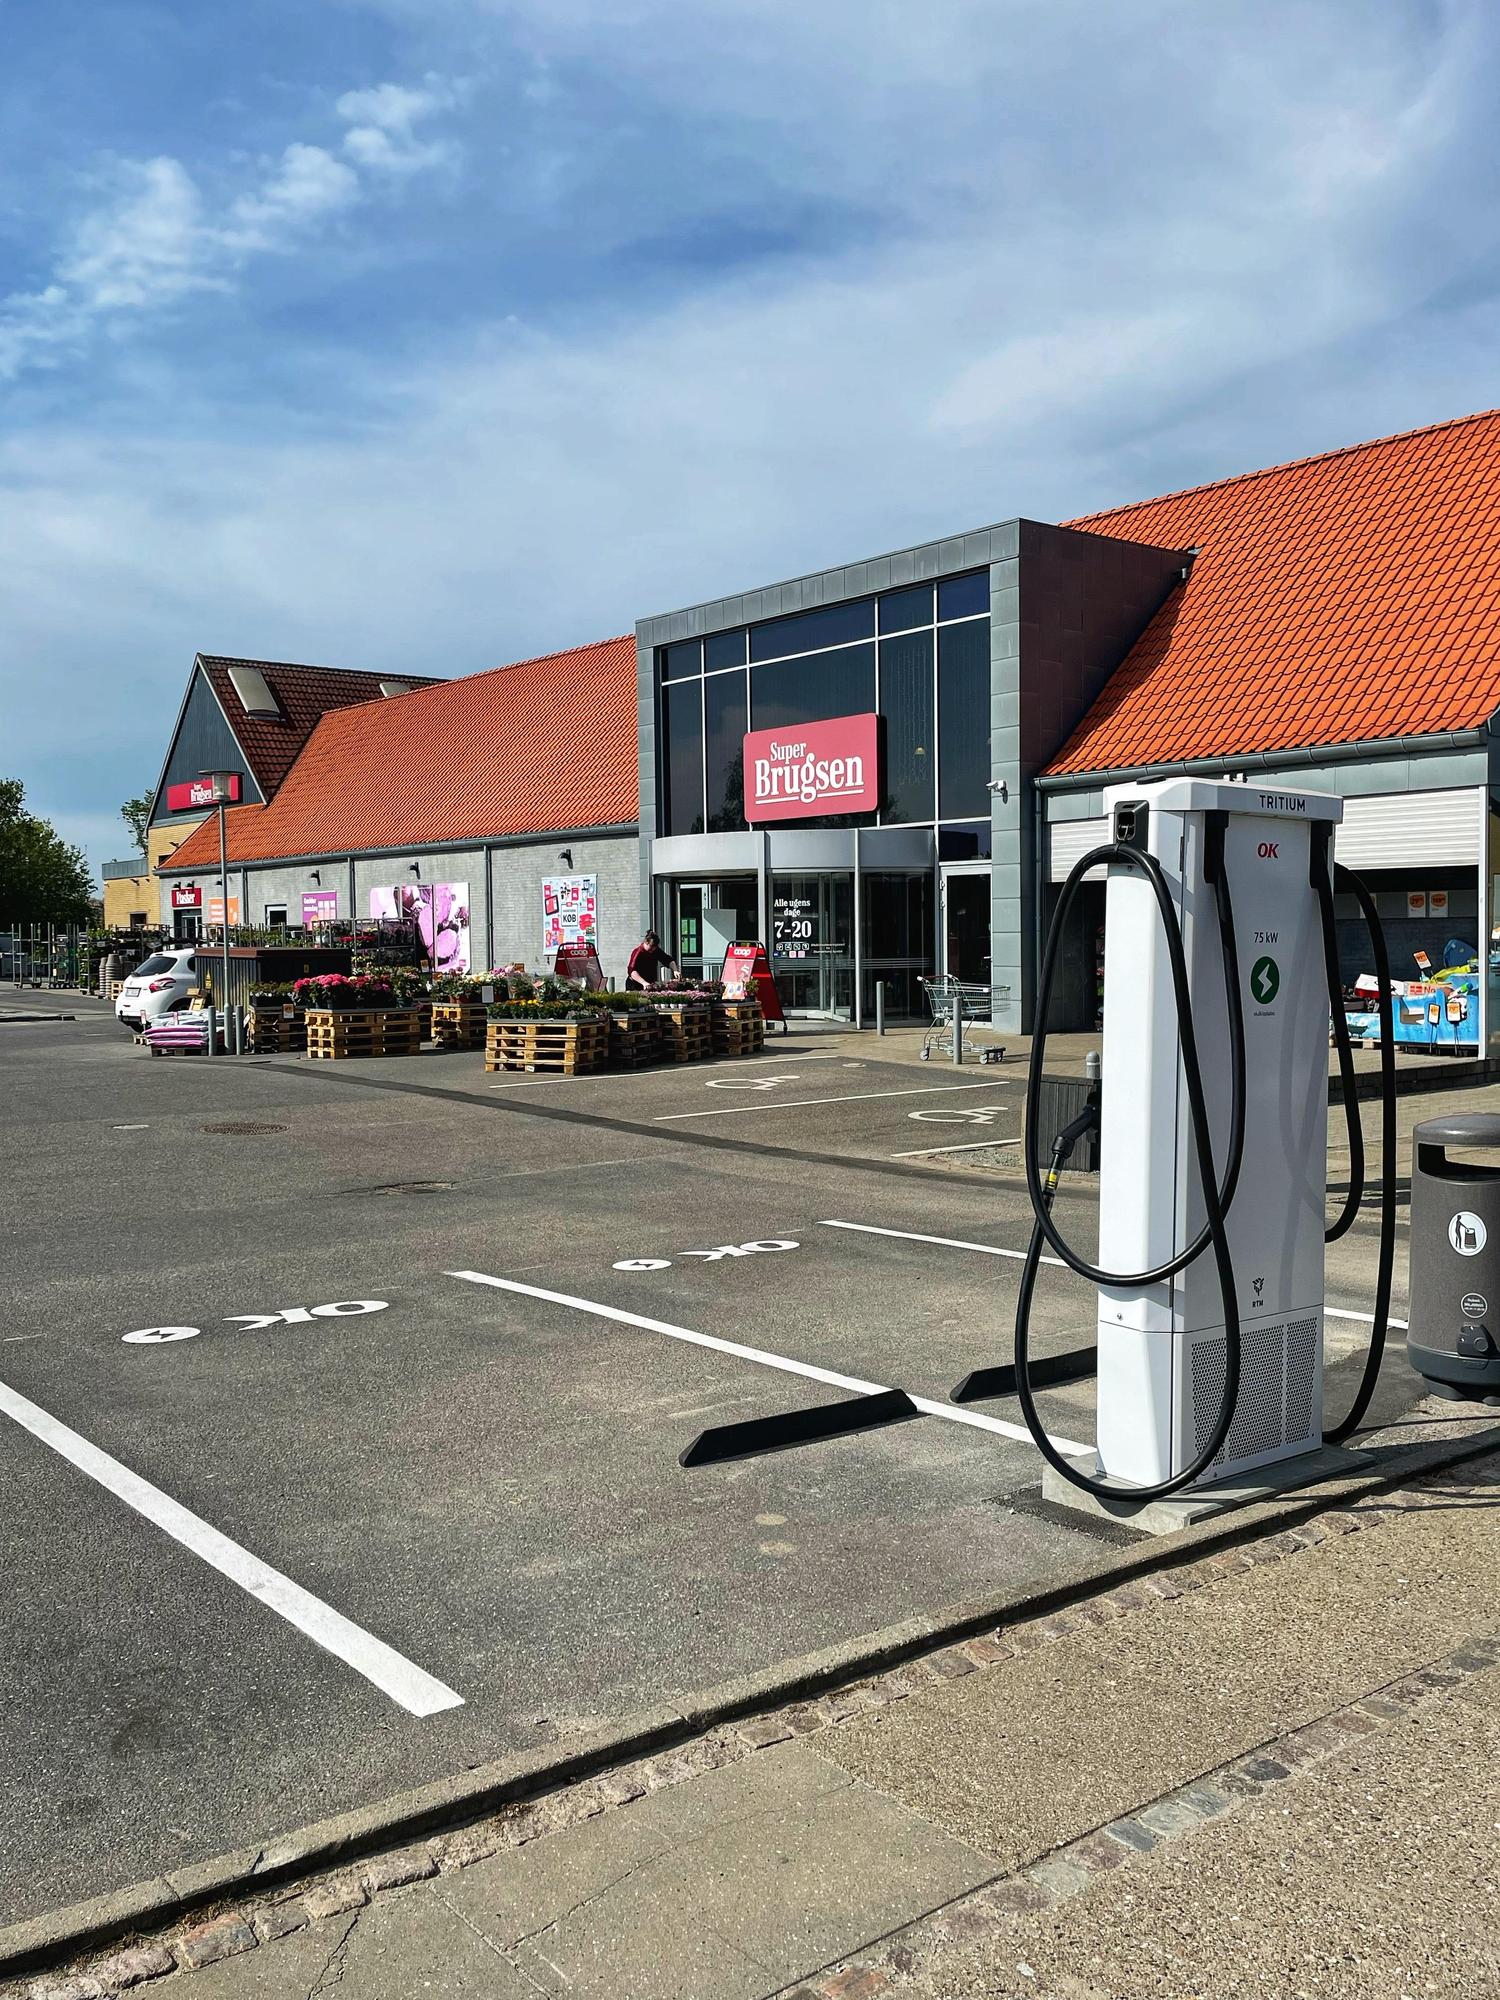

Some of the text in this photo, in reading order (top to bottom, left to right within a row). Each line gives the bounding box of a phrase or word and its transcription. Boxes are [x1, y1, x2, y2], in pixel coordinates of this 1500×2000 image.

[769, 741, 807, 765] Super
[754, 752, 865, 804] Brugsen
[1259, 794, 1306, 812] TRITIUM
[1257, 842, 1280, 859] OK
[774, 898, 811, 908] Alle ugens
[783, 907, 801, 918] dage
[774, 920, 812, 939] 7-20
[1254, 931, 1279, 943] 75 kW
[734, 948, 752, 957] coop
[677, 1239, 801, 1262] OK
[222, 1300, 390, 1331] OK
